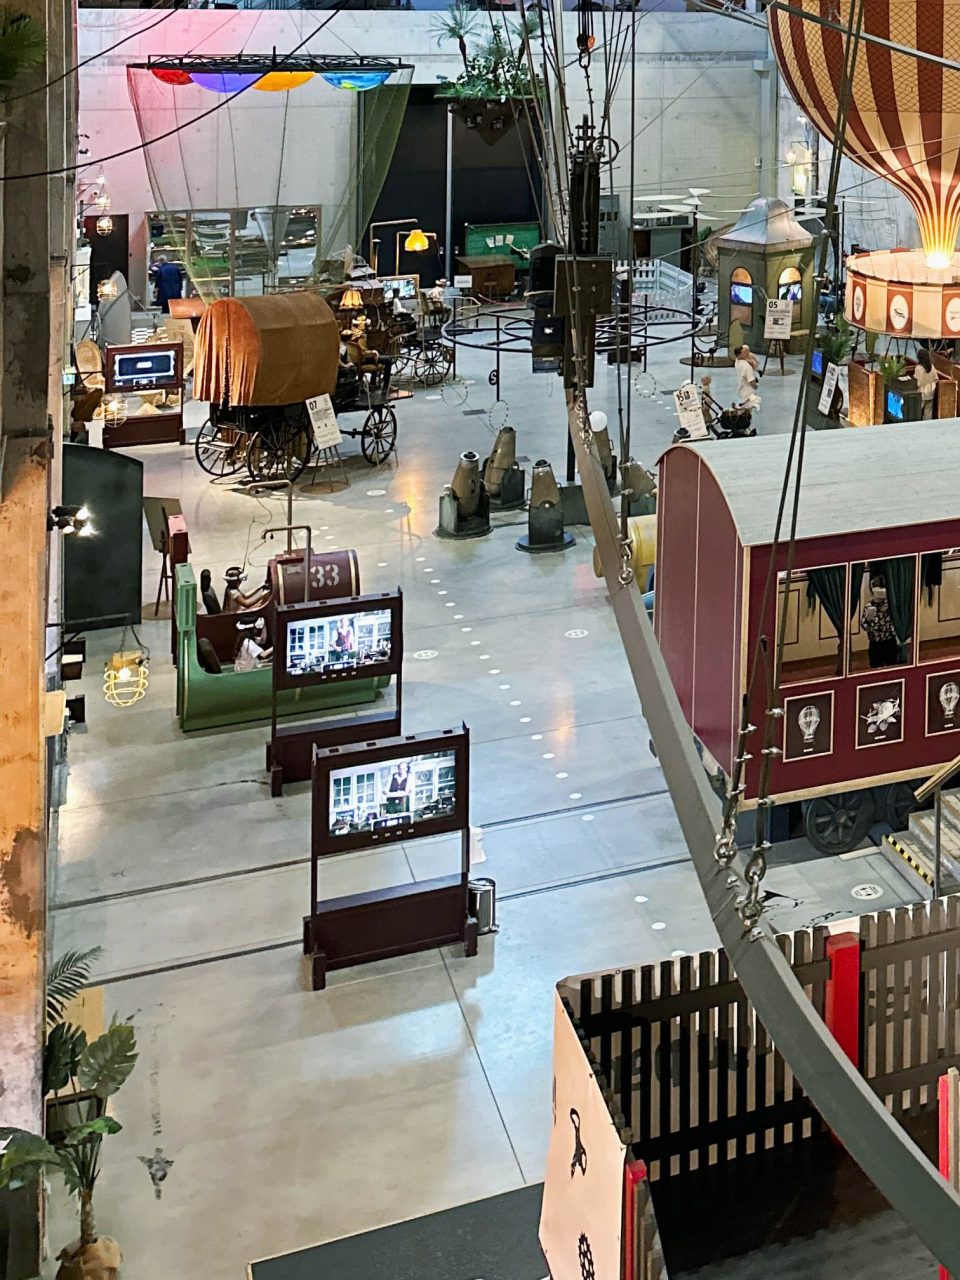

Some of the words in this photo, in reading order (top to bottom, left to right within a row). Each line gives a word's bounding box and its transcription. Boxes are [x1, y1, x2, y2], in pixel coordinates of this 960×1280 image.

[768, 301, 778, 309] 05
[309, 400, 317, 411] 07
[310, 564, 340, 588] 33
